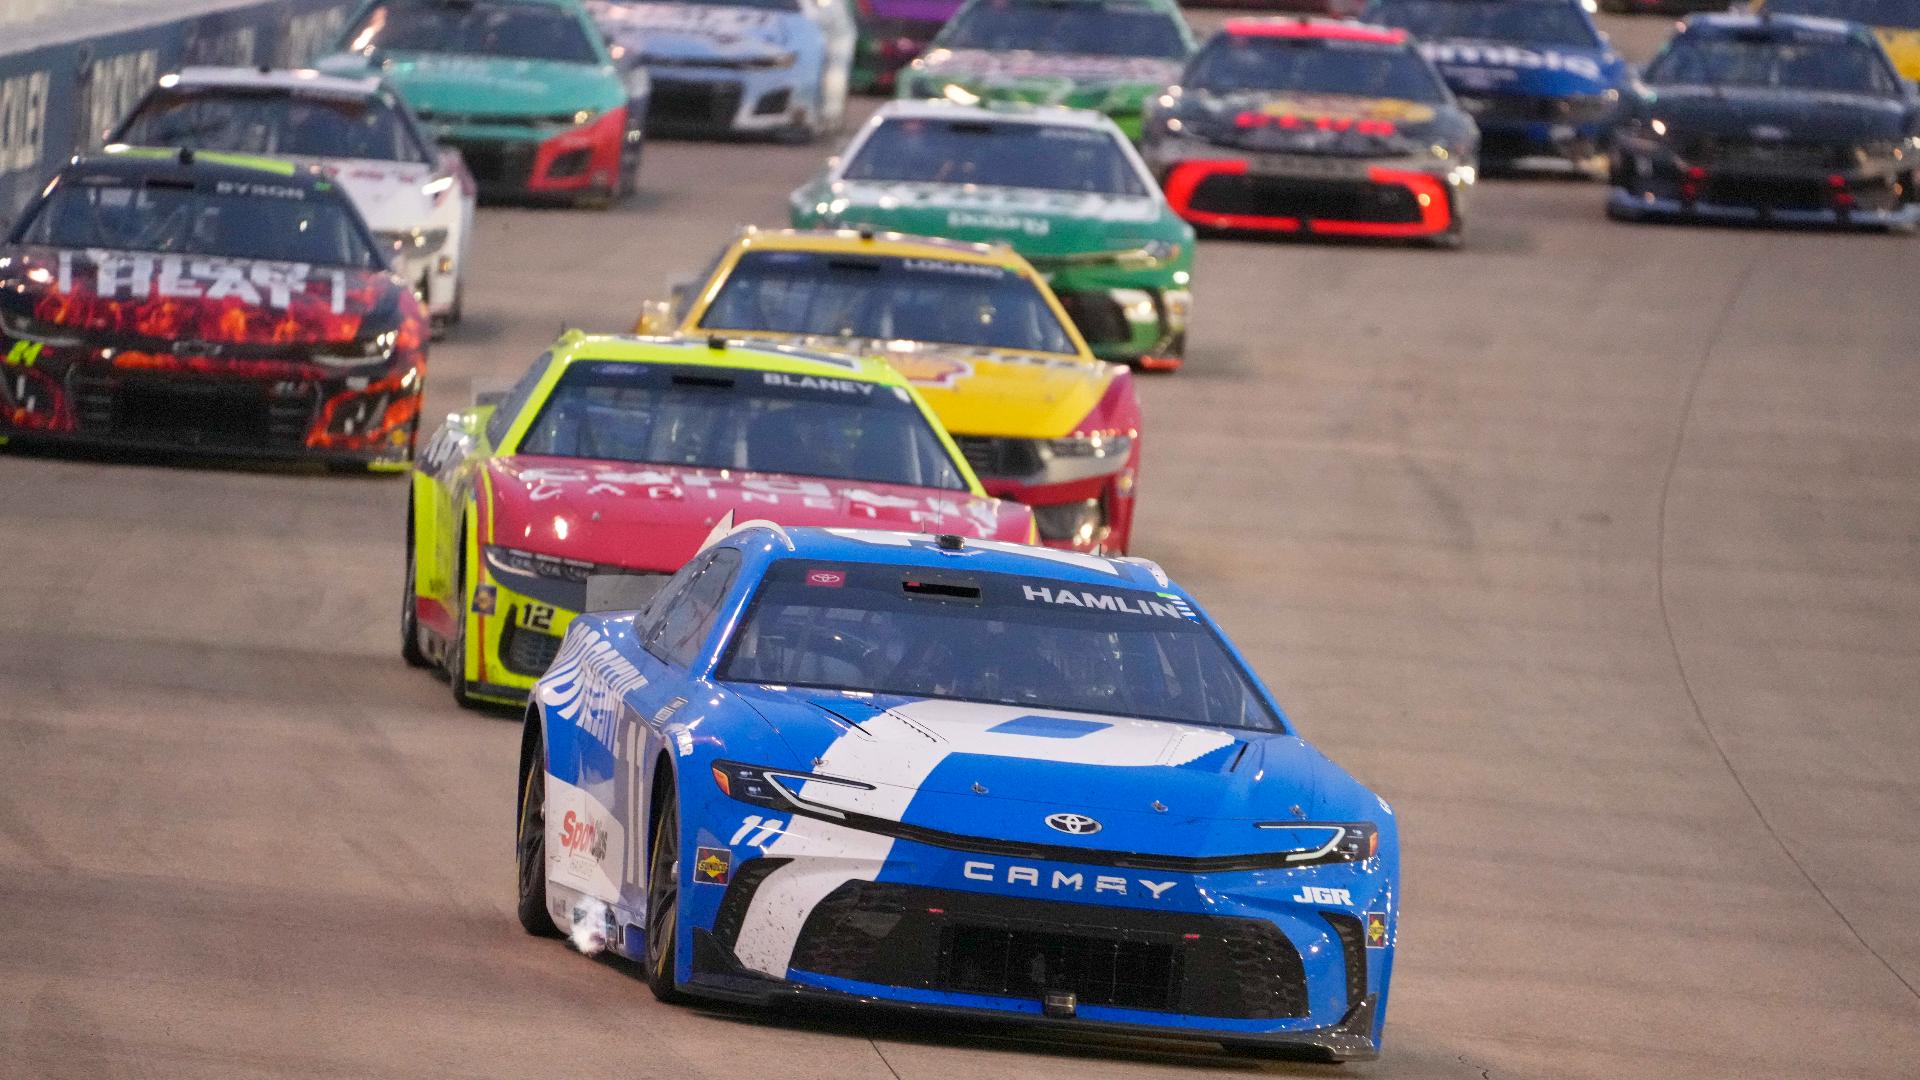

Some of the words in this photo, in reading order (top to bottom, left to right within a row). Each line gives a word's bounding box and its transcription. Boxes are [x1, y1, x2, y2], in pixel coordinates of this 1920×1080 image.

[762, 372, 875, 395] BLANEY
[523, 602, 555, 630] 12
[1022, 584, 1182, 620] HAMLIN
[729, 814, 784, 847] 11
[963, 860, 1179, 900] CAMRY
[1292, 885, 1355, 906] JGR
